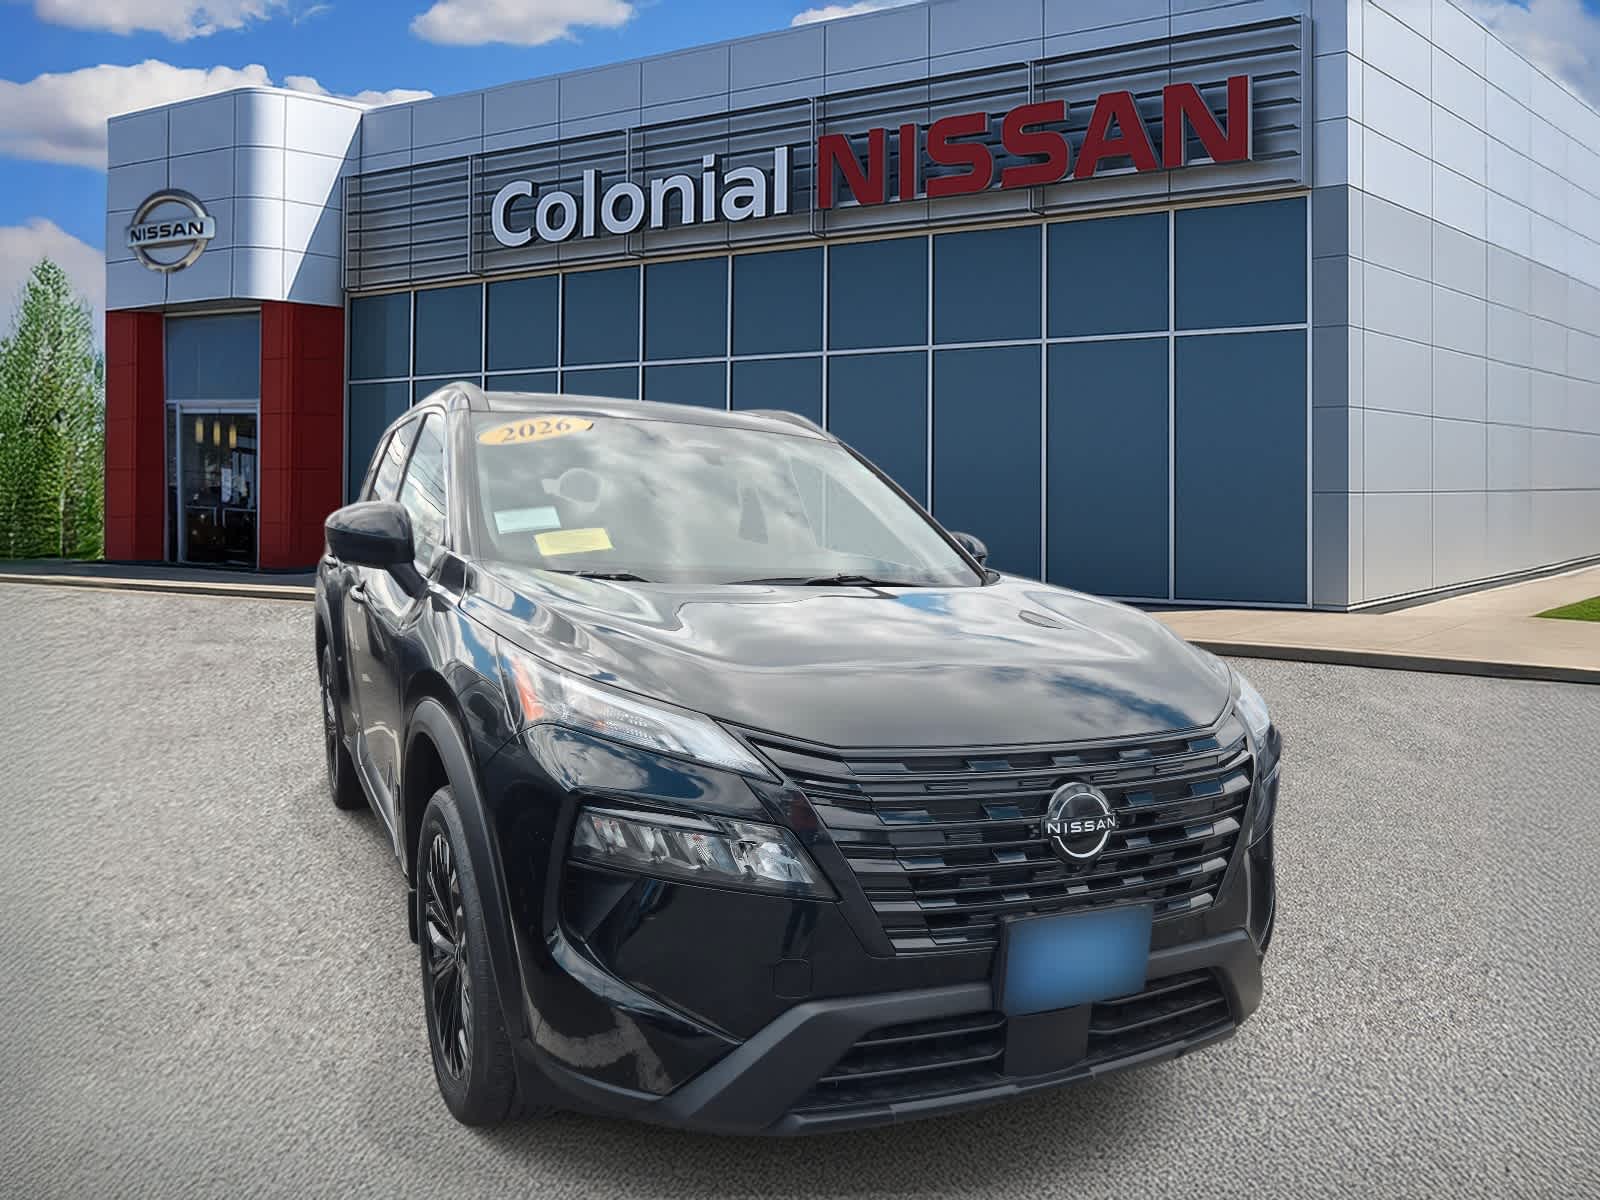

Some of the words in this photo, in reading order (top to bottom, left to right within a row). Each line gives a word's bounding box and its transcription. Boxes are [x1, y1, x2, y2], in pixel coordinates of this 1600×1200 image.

[490, 146, 790, 248] Colonial
[817, 74, 1253, 210] NISSAN
[130, 221, 204, 242] NISSAN
[501, 420, 571, 442] 2026
[1047, 815, 1116, 834] NISSAN
